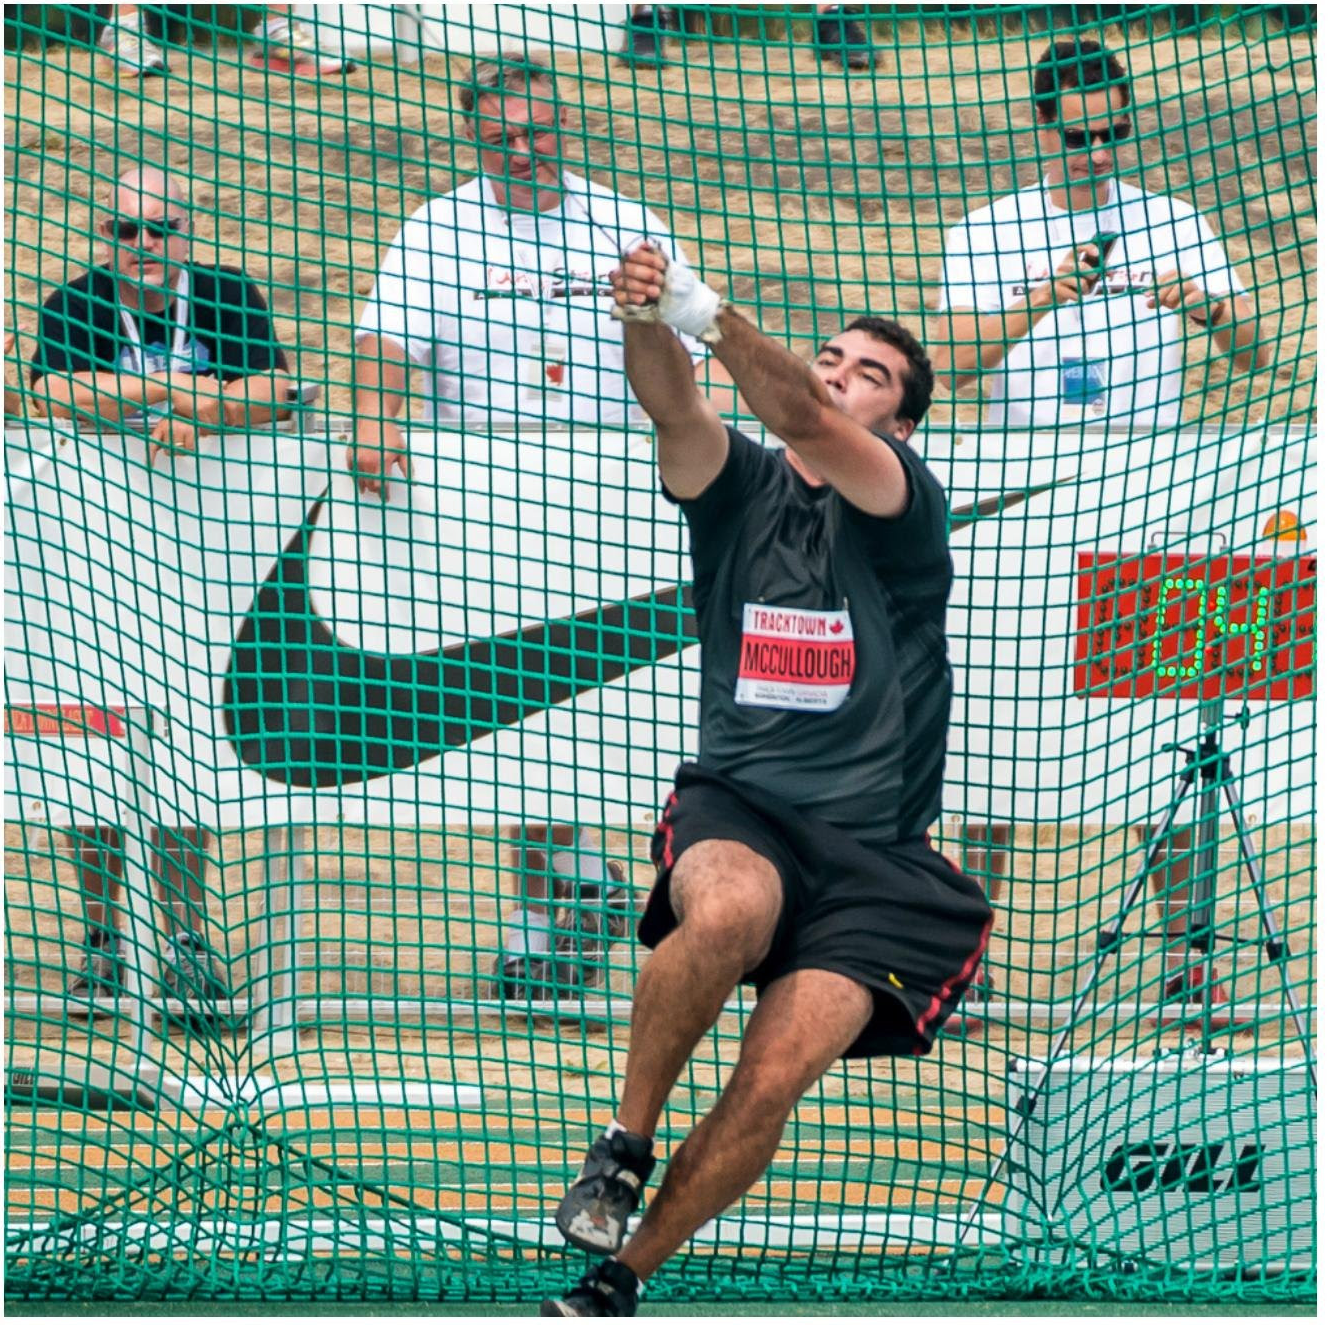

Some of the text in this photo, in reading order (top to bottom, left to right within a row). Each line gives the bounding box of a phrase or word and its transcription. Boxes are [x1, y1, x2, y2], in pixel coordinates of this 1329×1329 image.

[754, 611, 827, 636] TRACKTOWN
[744, 642, 851, 678] MCCULLOUGH
[1101, 1144, 1265, 1192] GILL
